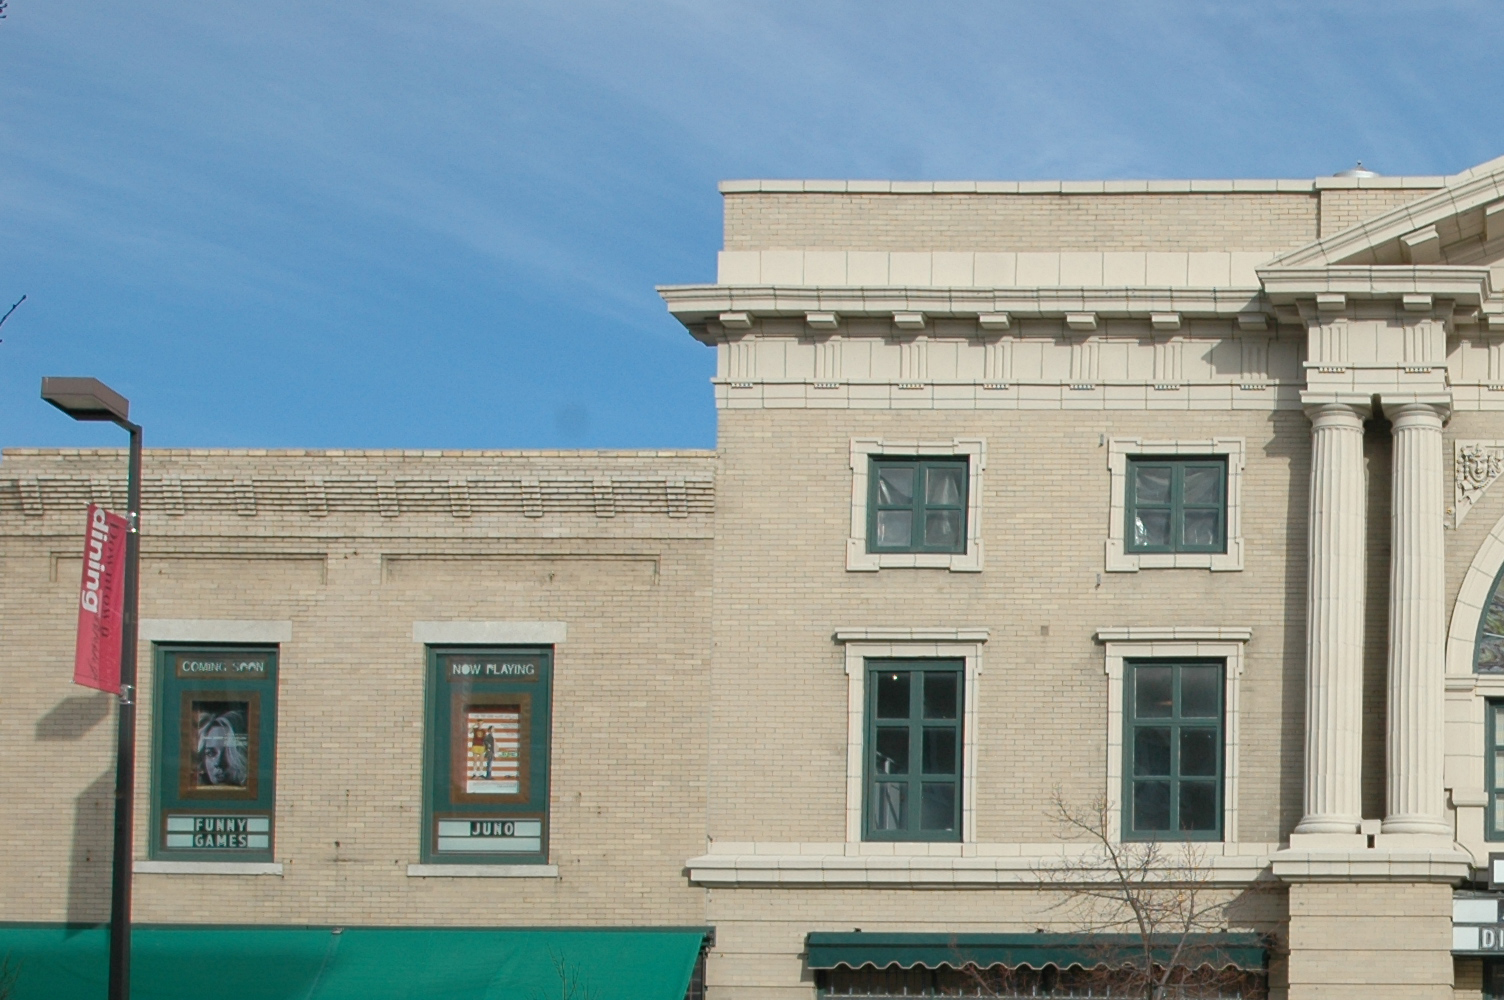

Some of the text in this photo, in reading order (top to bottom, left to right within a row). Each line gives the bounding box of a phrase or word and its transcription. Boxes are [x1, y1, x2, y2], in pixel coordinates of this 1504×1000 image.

[82, 508, 109, 613] dining
[182, 661, 226, 672] COMING
[452, 664, 535, 675] NOW PLAYING
[196, 818, 247, 832] FUNNY
[472, 823, 513, 836] JUNO
[195, 834, 247, 848] GAMES
